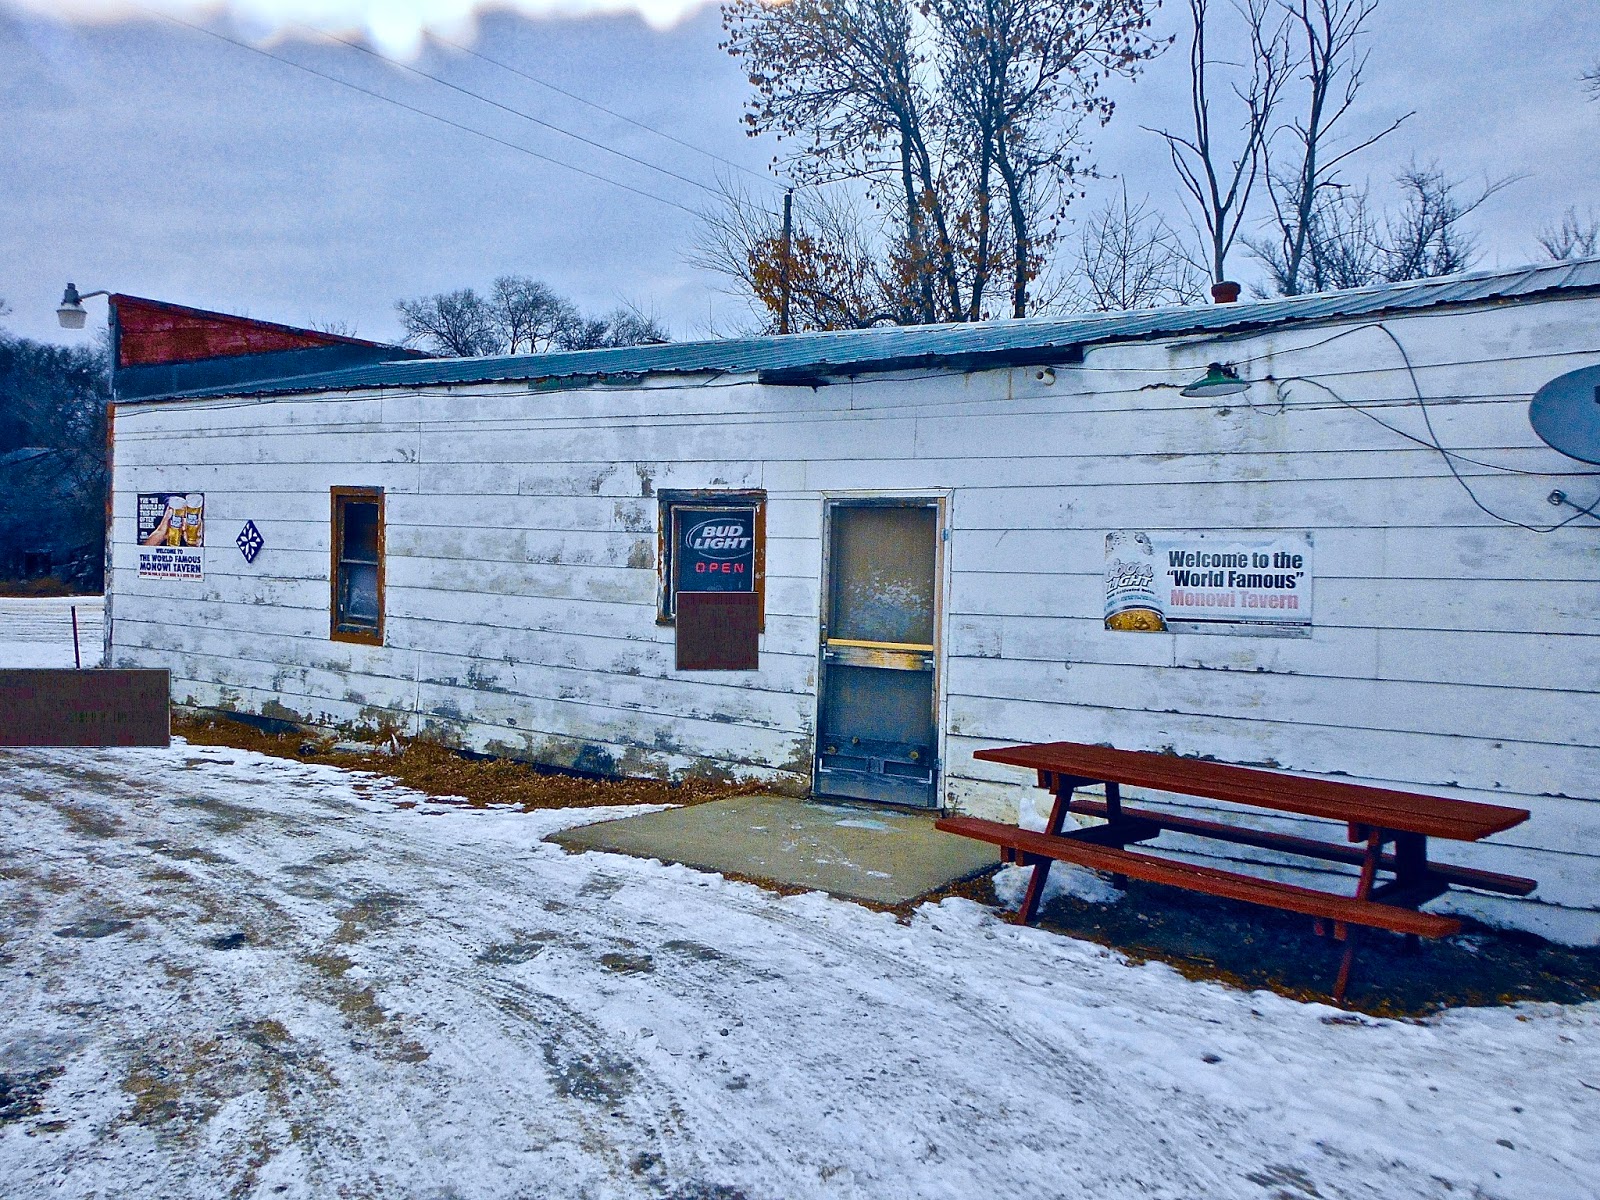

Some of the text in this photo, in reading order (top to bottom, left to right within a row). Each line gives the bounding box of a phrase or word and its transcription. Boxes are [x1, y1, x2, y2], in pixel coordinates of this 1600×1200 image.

[702, 525, 744, 537] BUD
[693, 537, 752, 550] LIGHT
[140, 554, 201, 564] THE WORLD FAMOUS
[1168, 550, 1303, 569] Welcome to the
[140, 562, 202, 573] MONOWI TAVERN
[695, 562, 744, 574] OPEN
[1105, 574, 1153, 594] LIGHT
[1170, 589, 1236, 608] Monowi
[1240, 590, 1299, 610] Tavern
